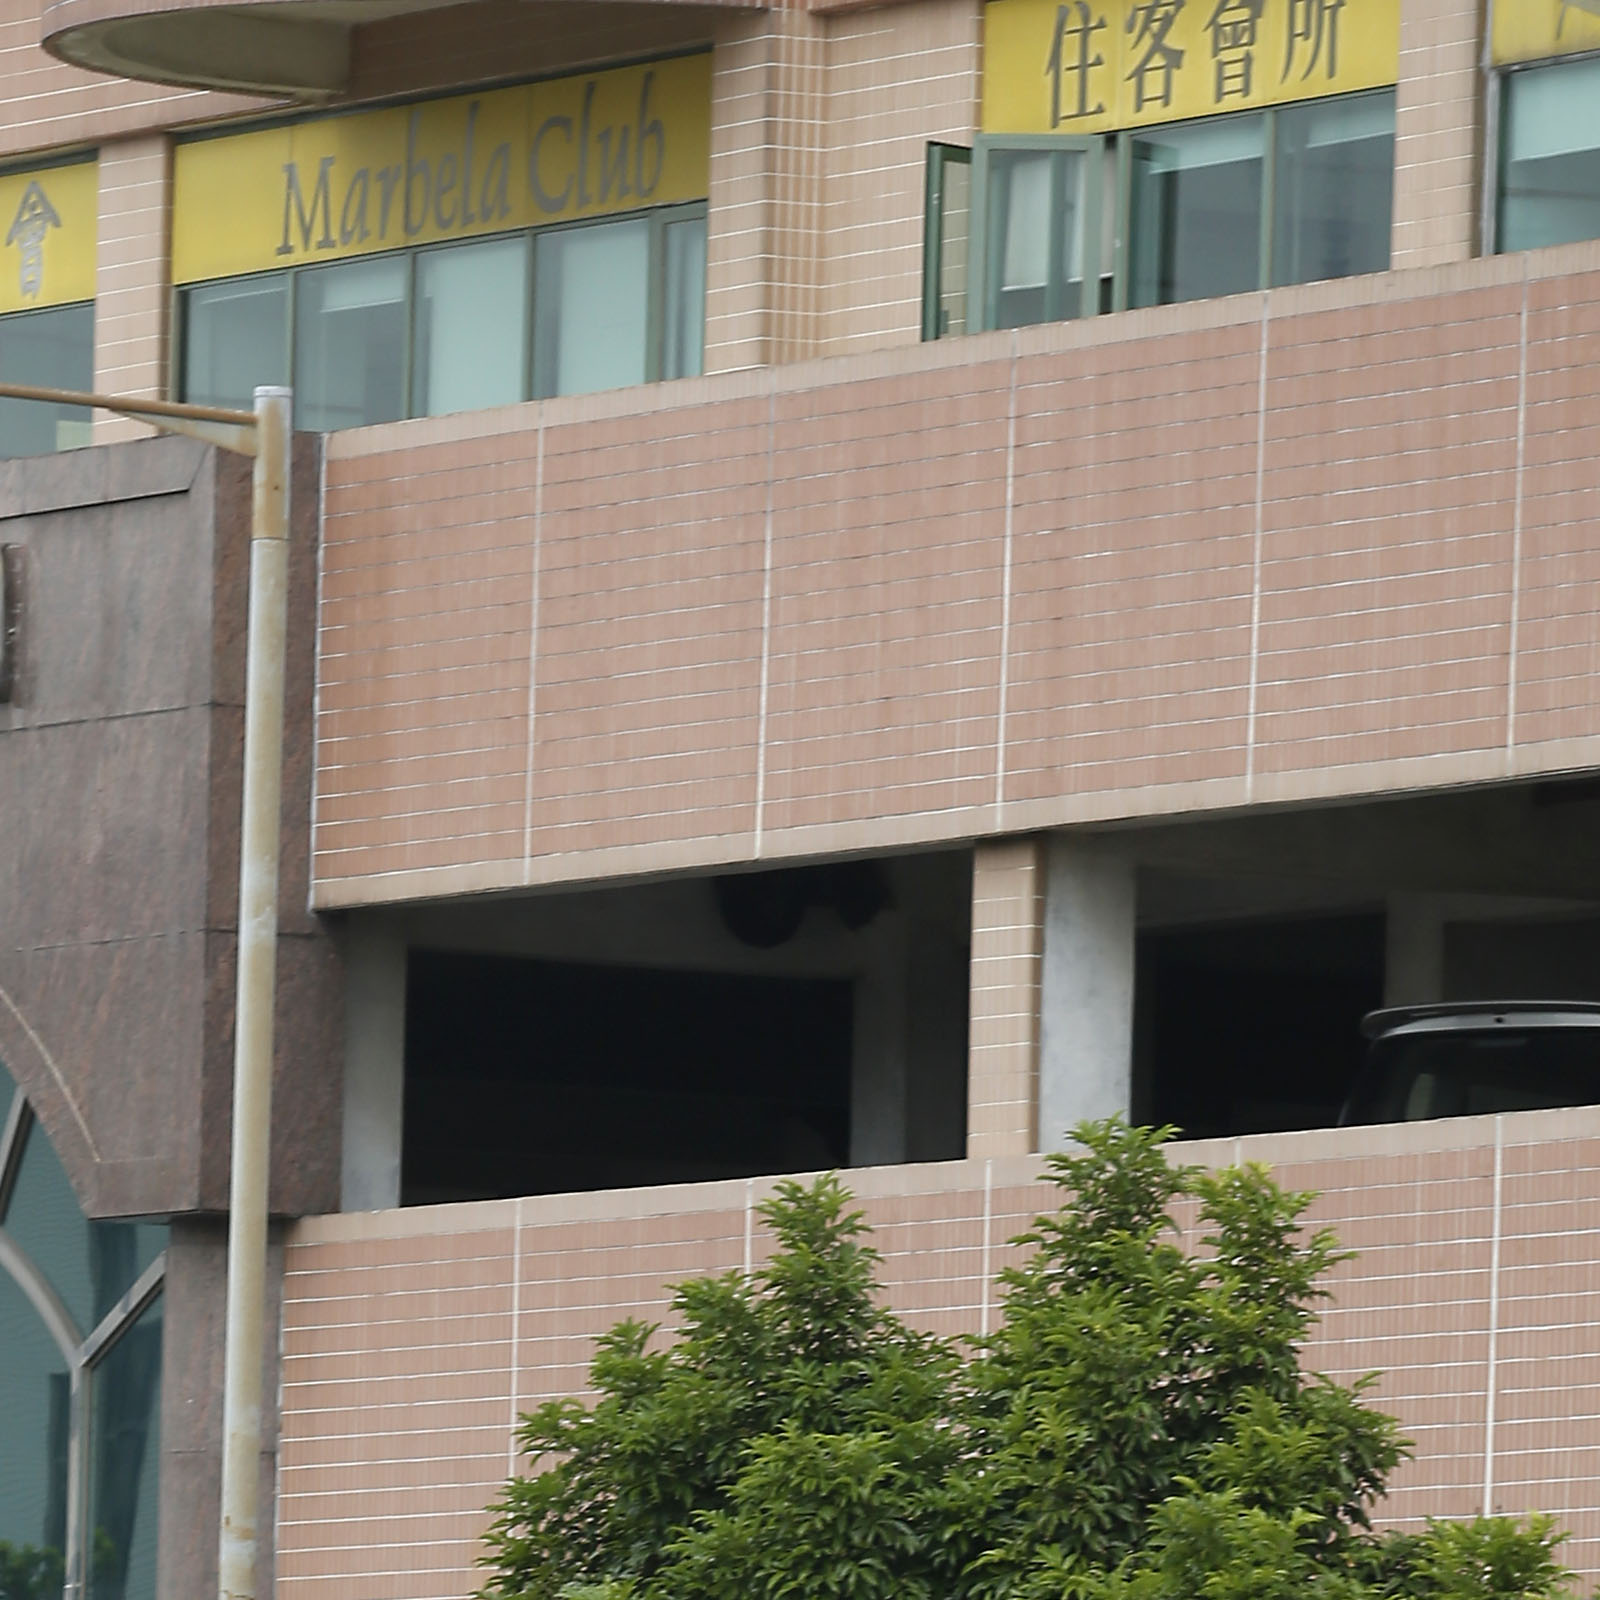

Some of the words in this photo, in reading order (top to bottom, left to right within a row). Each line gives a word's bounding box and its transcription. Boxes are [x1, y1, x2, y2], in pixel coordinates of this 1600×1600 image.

[1045, 0, 1347, 128] 住客會所
[275, 100, 512, 257] Marbela
[527, 70, 667, 216] Club
